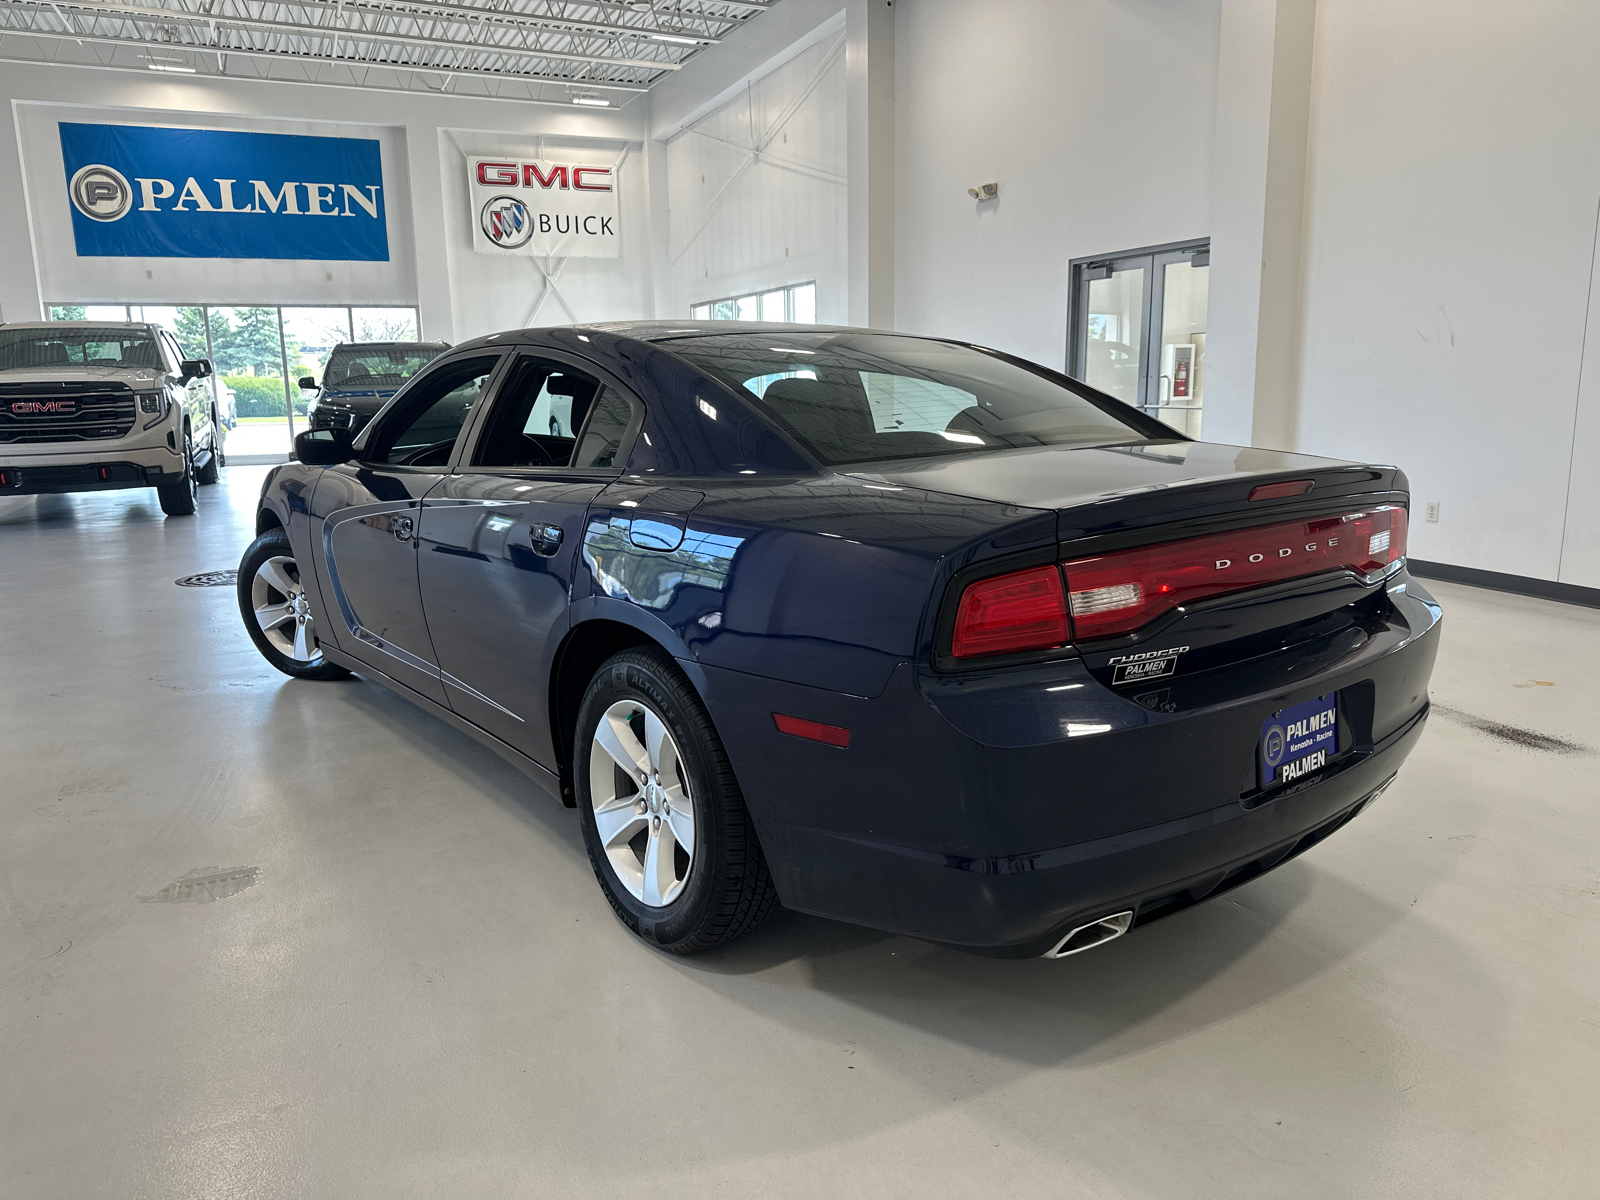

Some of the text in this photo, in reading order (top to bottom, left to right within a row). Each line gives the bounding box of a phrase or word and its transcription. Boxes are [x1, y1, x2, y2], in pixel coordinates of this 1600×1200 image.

[476, 160, 612, 193] GMC
[134, 177, 380, 218] PALMEN
[539, 213, 614, 236] BUICK
[12, 400, 76, 413] GMC
[1215, 537, 1338, 570] DODGE
[1125, 660, 1167, 675] PALMEN
[632, 675, 675, 720] ALTIMAX
[1286, 707, 1337, 742] PALMEN
[1290, 738, 1313, 753] Kenosha
[1316, 730, 1333, 742] Racine
[1282, 749, 1326, 783] PALMEN
